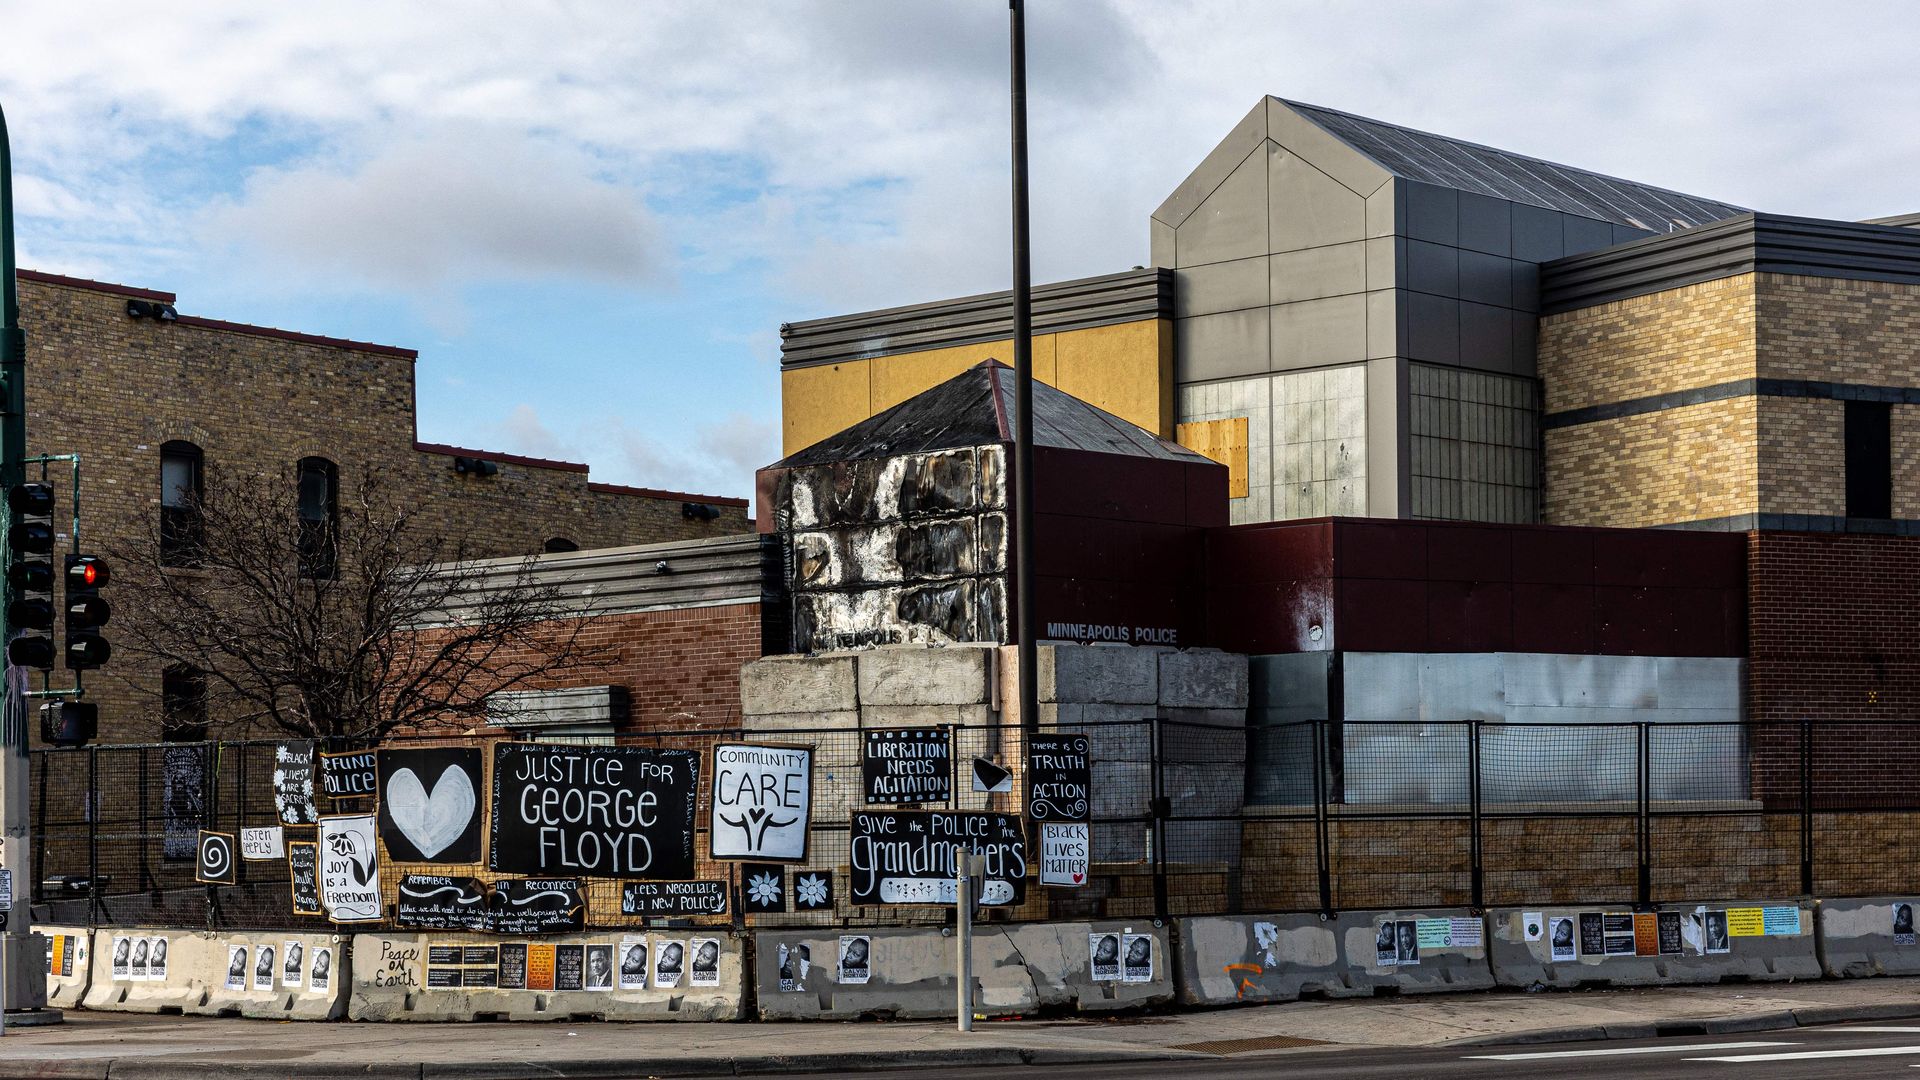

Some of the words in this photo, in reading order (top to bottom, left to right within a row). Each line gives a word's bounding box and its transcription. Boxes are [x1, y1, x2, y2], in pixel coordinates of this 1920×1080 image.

[1047, 622, 1130, 641] MINNEAPOLIS
[1135, 626, 1177, 643] POLICE
[287, 753, 309, 764] BLACK
[1031, 755, 1085, 770] TRUTH
[641, 762, 674, 785] FOR
[1055, 773, 1067, 781] IN
[719, 770, 803, 809] CARE
[874, 776, 949, 794] AGITATION
[1032, 783, 1086, 799] ACTION
[540, 827, 653, 873] FLOYD
[327, 861, 349, 874] JOY
[339, 878, 347, 887] a
[430, 904, 440, 913] all
[637, 900, 644, 910] a
[508, 925, 522, 934] long
[380, 941, 420, 960] Peace
[375, 969, 419, 988] Earth
